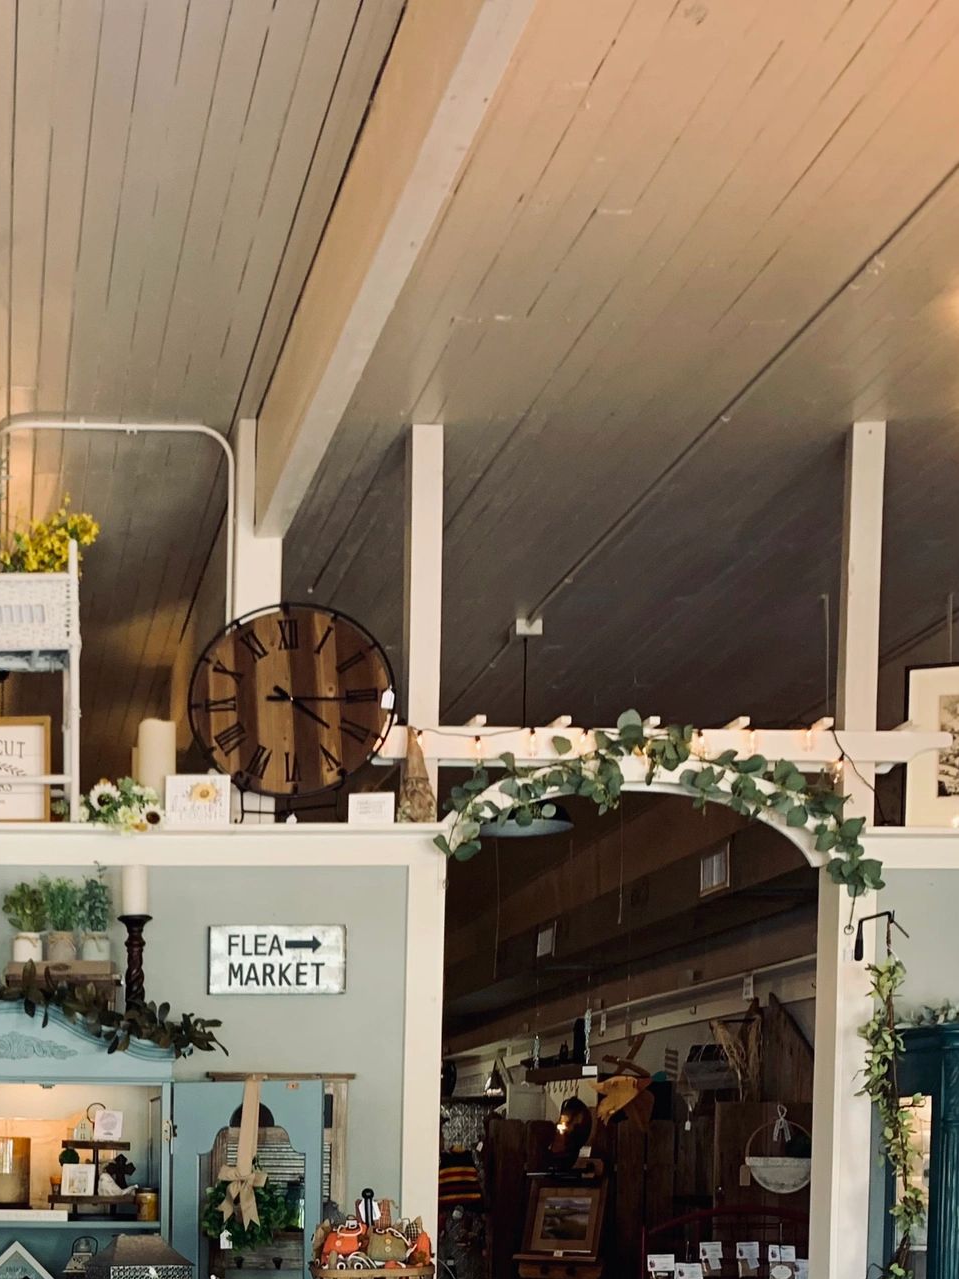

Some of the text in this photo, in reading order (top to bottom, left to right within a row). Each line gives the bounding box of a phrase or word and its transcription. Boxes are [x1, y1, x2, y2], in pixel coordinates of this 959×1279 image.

[240, 629, 269, 662] XI
[278, 620, 299, 650] XII
[314, 626, 334, 654] I
[212, 660, 243, 685] X
[205, 697, 236, 712] IX
[228, 934, 283, 956] FLEA
[228, 962, 325, 986] MARKET
